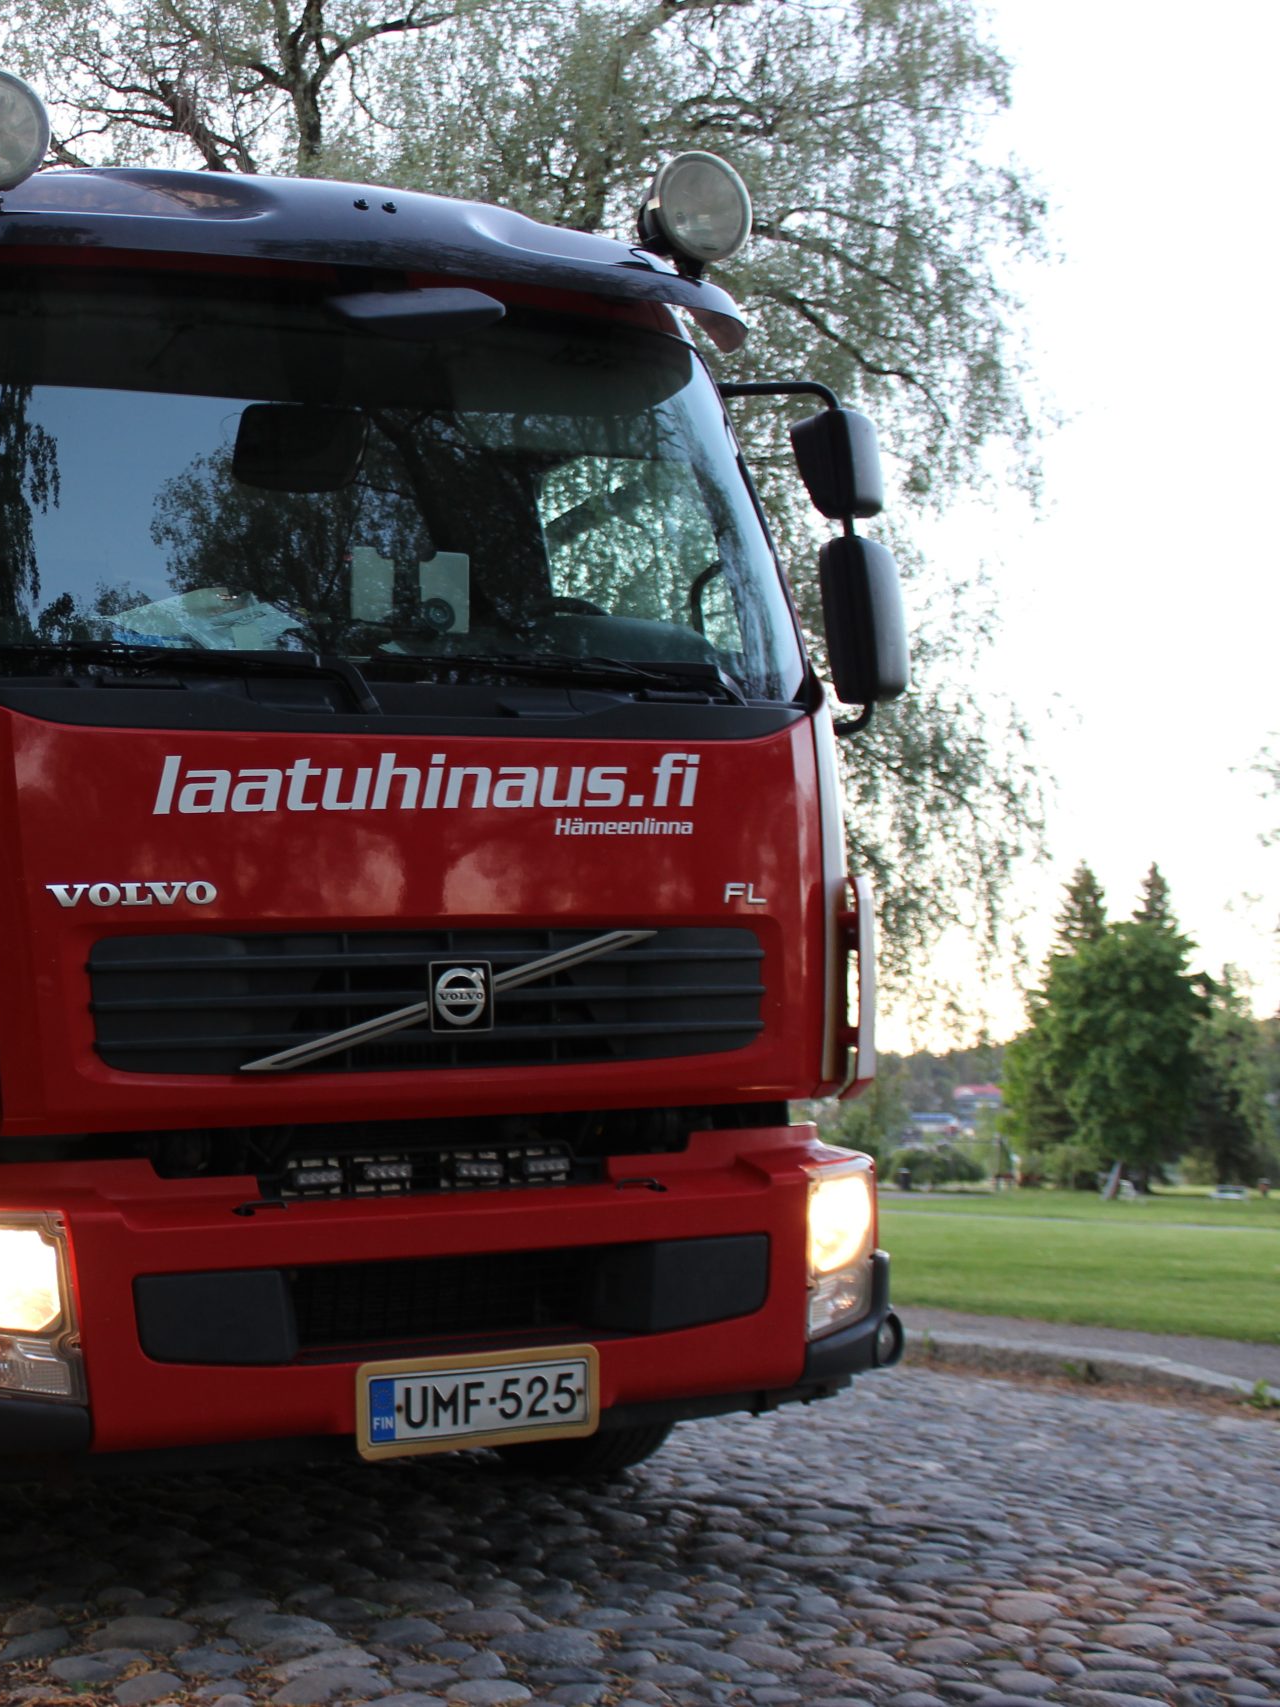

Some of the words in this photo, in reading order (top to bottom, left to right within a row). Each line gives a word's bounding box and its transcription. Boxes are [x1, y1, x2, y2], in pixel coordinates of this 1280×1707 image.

[153, 753, 700, 815] laatuhinaus.fi
[554, 817, 694, 836] Hämeenlinna
[46, 880, 217, 907] VOLVO
[724, 883, 767, 904] FL
[439, 992, 483, 1001] VOLVO
[372, 1415, 394, 1432] FIN
[404, 1372, 578, 1430] UMF-525
